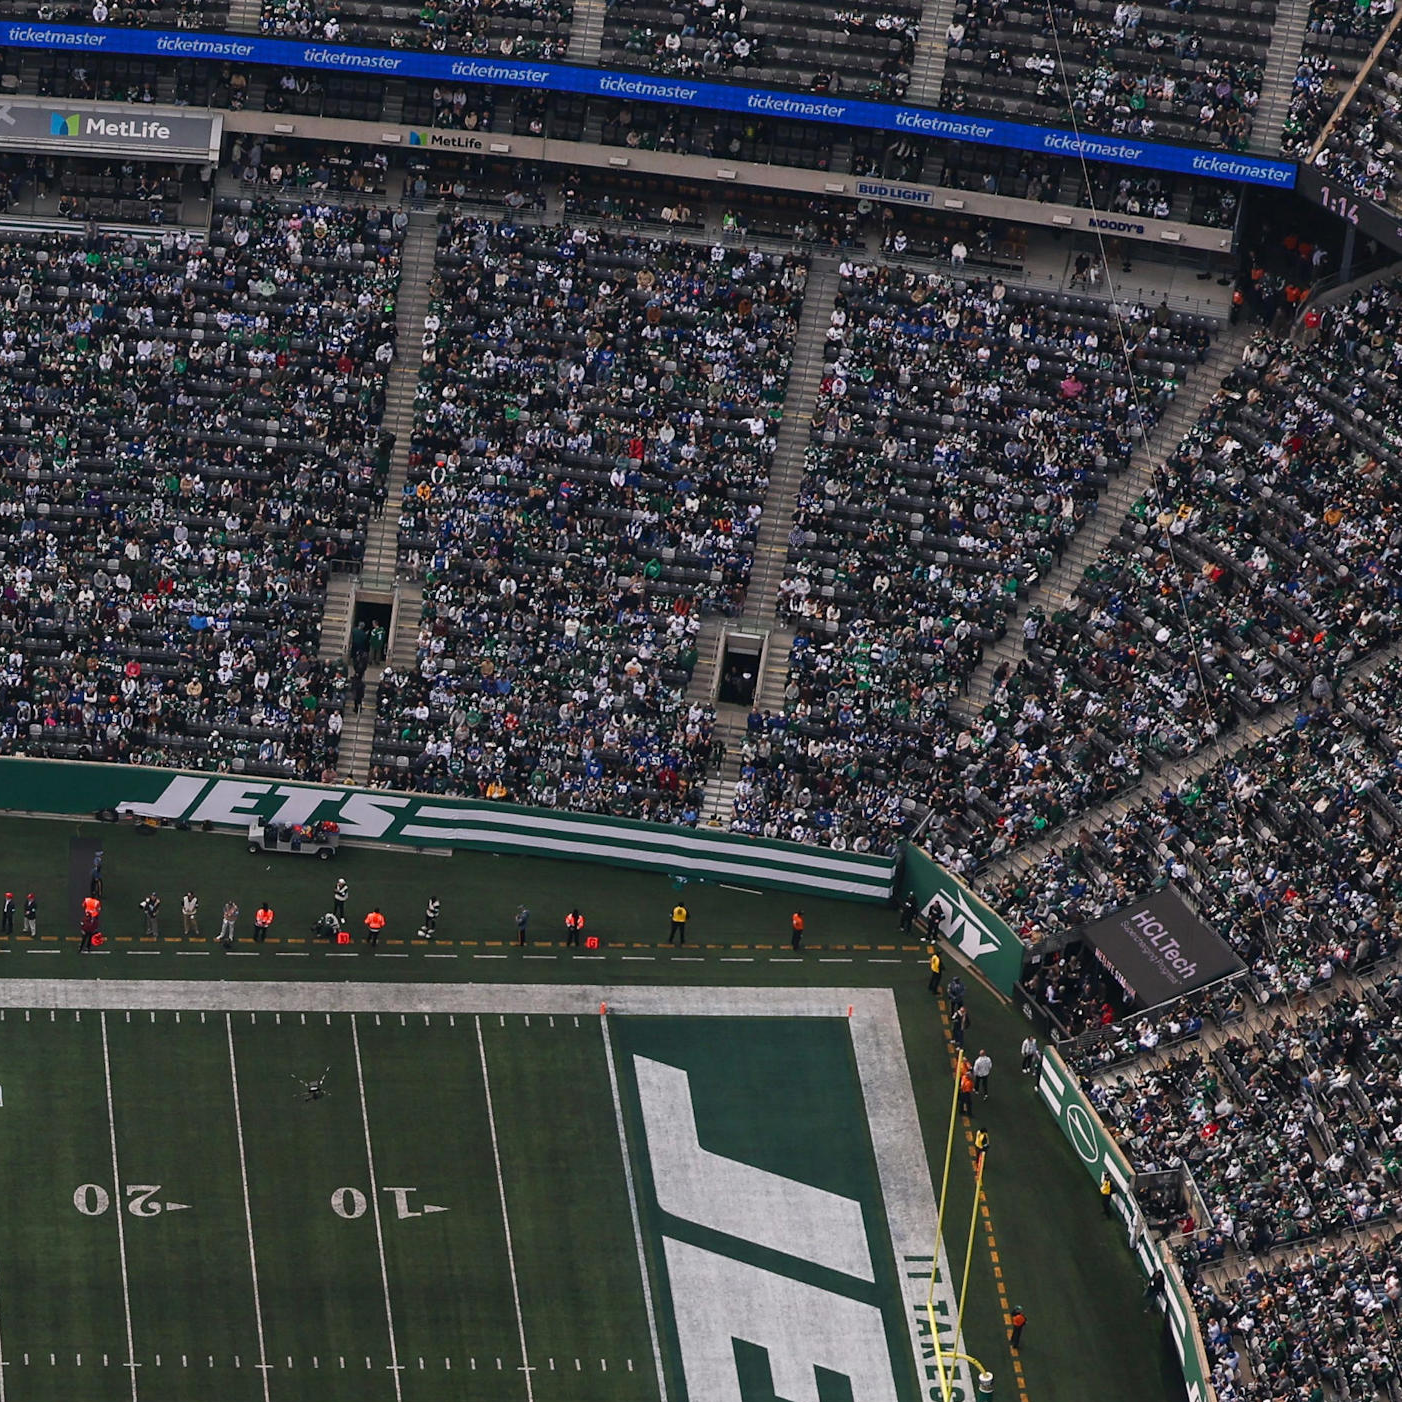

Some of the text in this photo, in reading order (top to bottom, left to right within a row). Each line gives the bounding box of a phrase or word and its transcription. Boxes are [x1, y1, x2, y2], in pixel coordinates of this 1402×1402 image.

[9, 26, 106, 46] ticketmaster
[157, 37, 254, 56] ticketmaster
[304, 48, 401, 70] ticketmaster
[452, 62, 549, 83] ticketmaster
[601, 76, 697, 100] ticketmaster
[747, 94, 845, 117] ticketmaster
[86, 119, 170, 140] MetLife
[896, 112, 994, 138] ticketmaster
[431, 133, 483, 150] MetLife
[1044, 134, 1141, 160] ticketmaster
[1193, 156, 1291, 182] ticketmaster
[858, 183, 931, 203] BUD LIGHT
[1089, 218, 1144, 234] MOODY'S
[117, 776, 411, 838] JETS
[1131, 910, 1197, 979] HCLTech
[74, 1184, 161, 1217] 20
[331, 1187, 421, 1219] 10
[903, 1255, 943, 1284] IT
